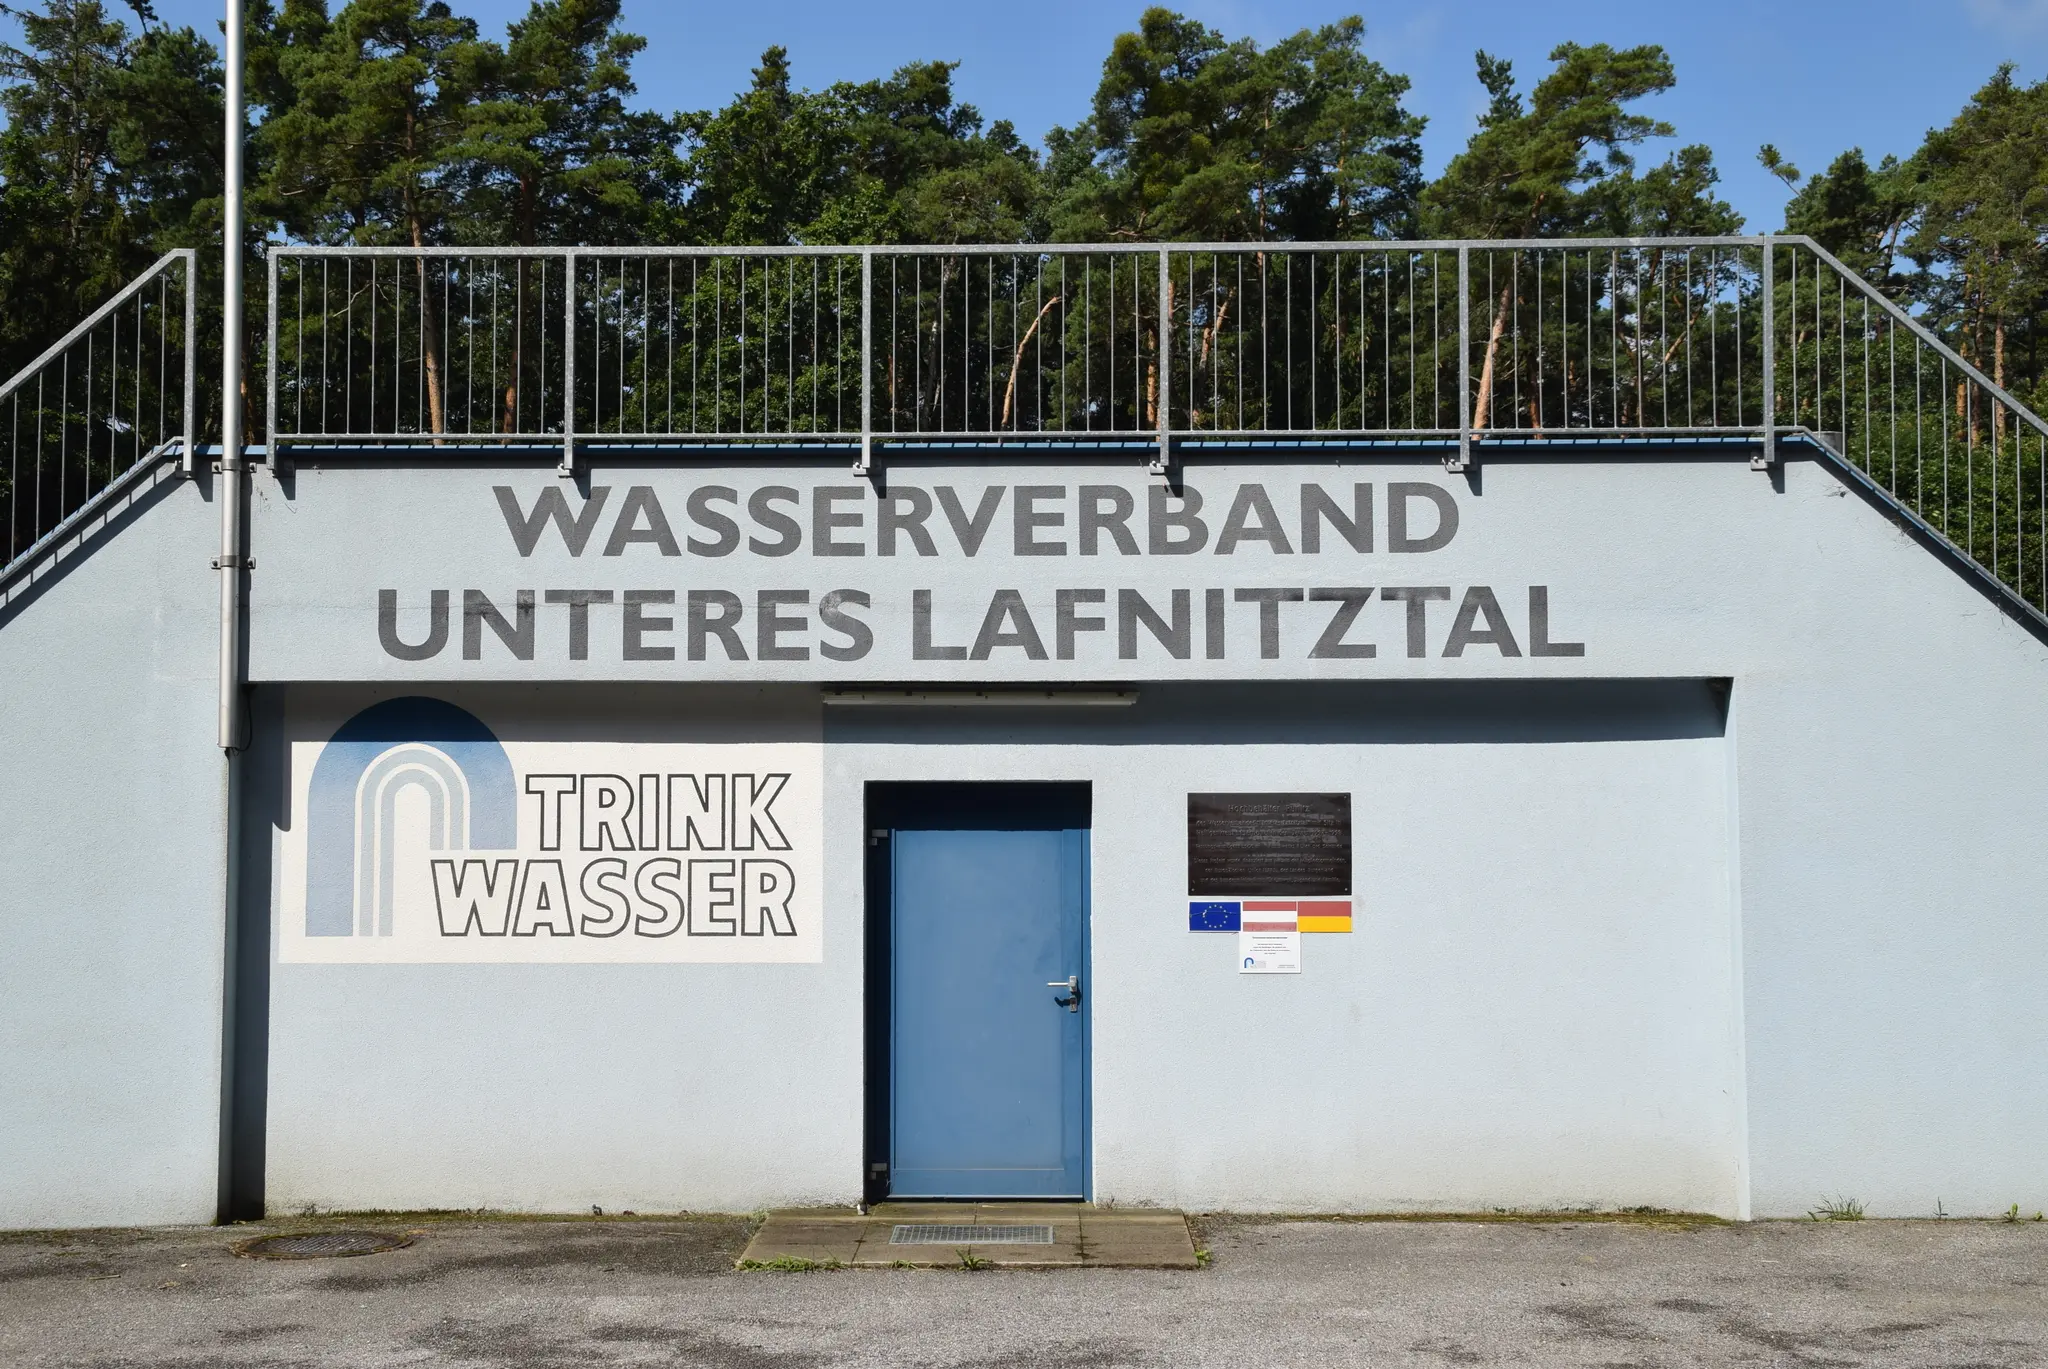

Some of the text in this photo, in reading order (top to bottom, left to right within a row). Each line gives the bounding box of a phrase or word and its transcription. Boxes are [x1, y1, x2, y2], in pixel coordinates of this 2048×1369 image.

[492, 482, 1459, 557] WASSERVERBAND
[377, 586, 1585, 661] UNTERES LAFNITZTAL
[525, 773, 793, 851] TRINK
[430, 857, 797, 937] WASSER
